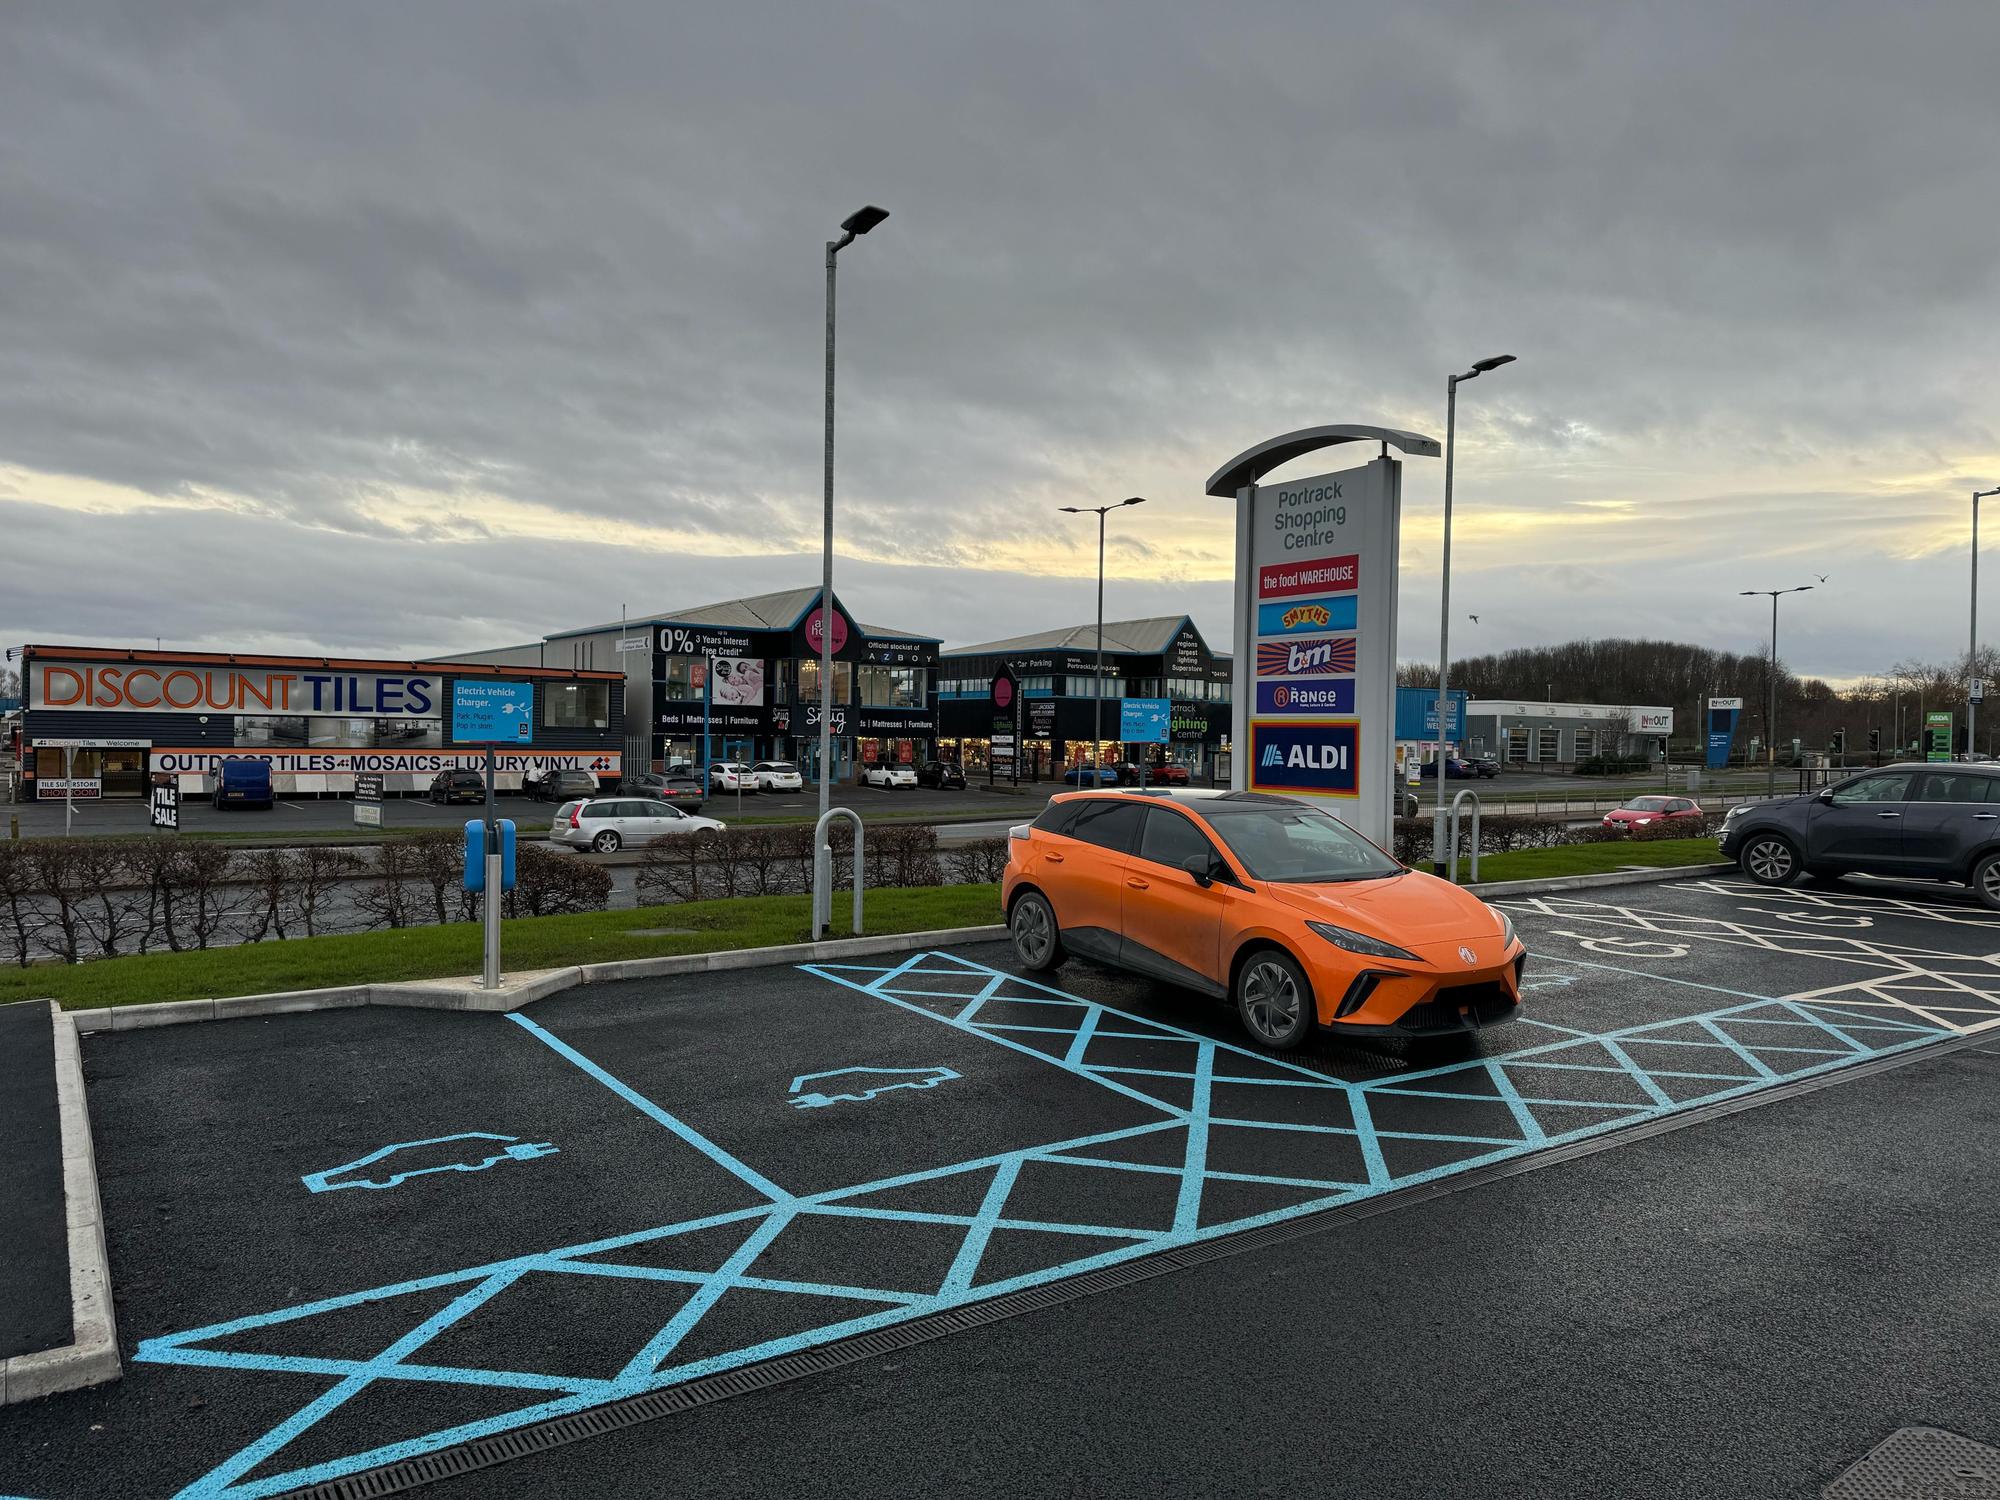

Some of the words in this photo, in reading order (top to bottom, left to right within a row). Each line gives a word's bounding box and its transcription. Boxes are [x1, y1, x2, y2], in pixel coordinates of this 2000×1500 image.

[1279, 481, 1343, 508] Portrack
[1275, 506, 1346, 531] Shopping
[1284, 529, 1334, 550] Centre
[1264, 576, 1277, 589] the
[1279, 572, 1298, 588] food
[1299, 565, 1353, 586] WAREHOUSE
[1283, 607, 1330, 627] SMYTHS
[660, 628, 694, 653] 0%
[695, 634, 701, 644] 3
[702, 635, 722, 645] Years
[723, 636, 749, 646] Interest
[43, 666, 297, 711] DISCOUNT
[303, 675, 432, 714] TILES
[457, 686, 486, 695] Electric
[487, 687, 516, 697] Vehicle
[457, 698, 491, 708] Charger.
[1170, 704, 1197, 713] ortrack
[662, 714, 679, 723] Beds
[687, 715, 723, 724] Mattrsses
[730, 716, 759, 725] Furniture
[1171, 716, 1208, 733] ghting
[1427, 722, 1457, 730] WELOME
[160, 754, 273, 771] OUTDR
[277, 755, 335, 771] TILES
[351, 755, 441, 771] MOSAICS
[533, 756, 584, 771] VINYL
[1287, 744, 1347, 770] ALDI
[155, 787, 176, 806] TILE
[154, 808, 176, 827] SALE
